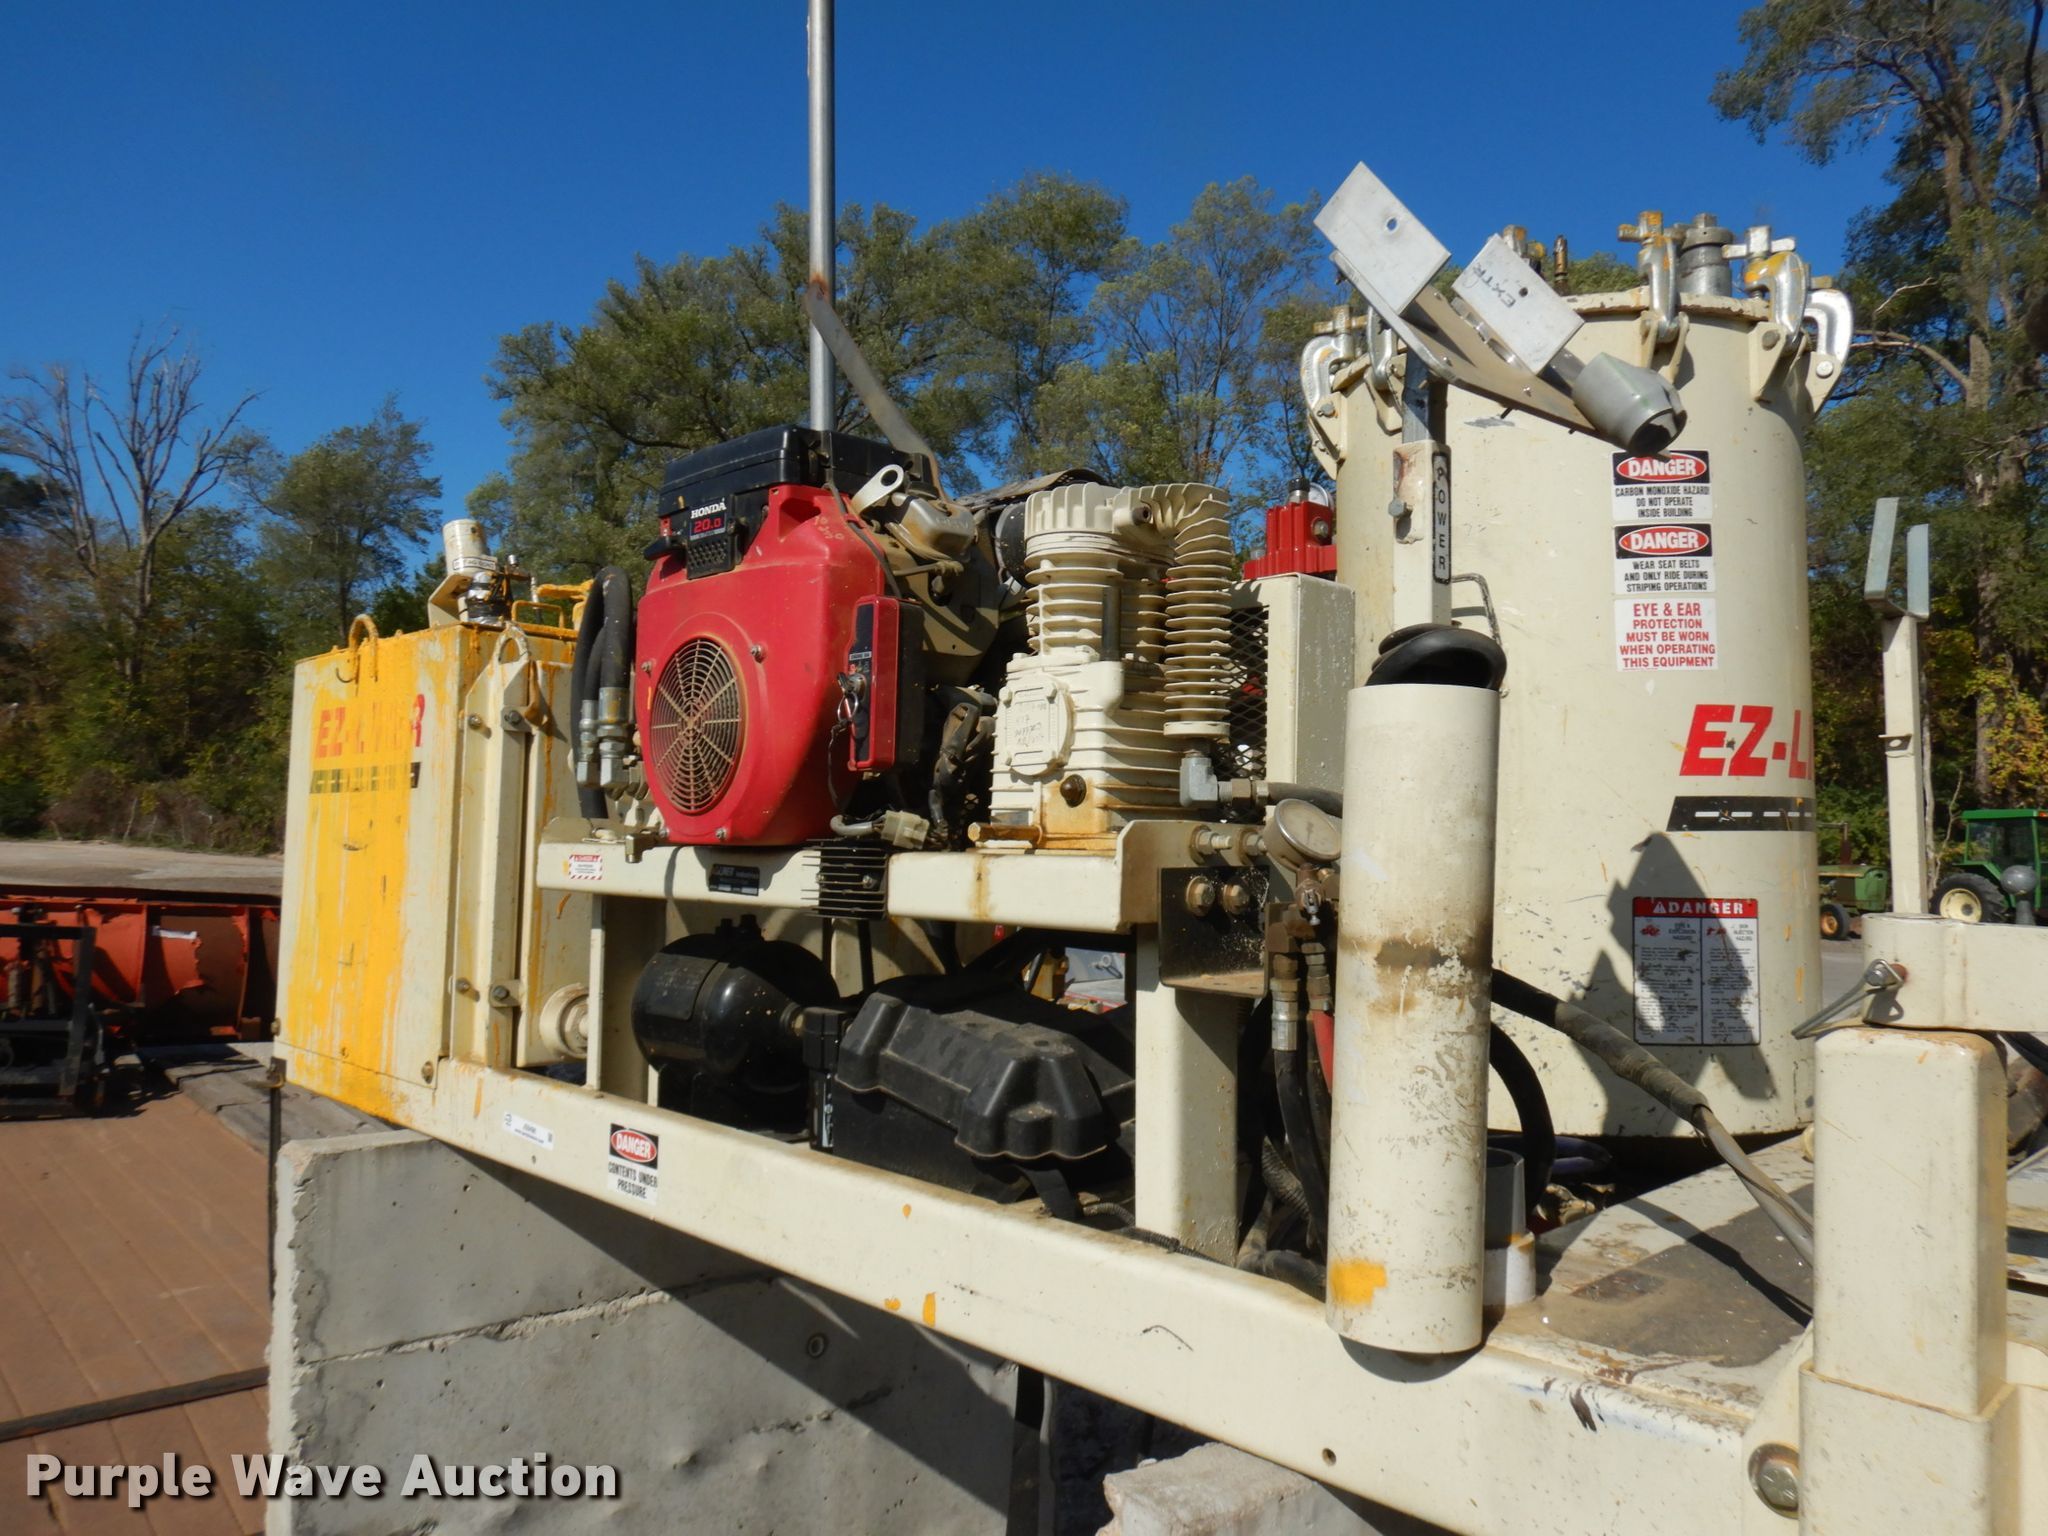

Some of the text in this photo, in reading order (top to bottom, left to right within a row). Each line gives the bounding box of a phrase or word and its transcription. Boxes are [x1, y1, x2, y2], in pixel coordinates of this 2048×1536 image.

[1628, 458, 1697, 477] DANGER
[1615, 486, 1710, 497] CARBON MONOXIDE HAZARD
[1636, 496, 1693, 507] DO NOT OPERATE
[690, 502, 727, 519] HONDA
[1638, 508, 1693, 518] INSIDE BUILDING
[1436, 467, 1447, 570] POWER
[694, 518, 721, 533] 20.0
[1630, 531, 1699, 550] DANGER
[1632, 559, 1700, 570] WEAR SEAT BELTS
[1624, 570, 1709, 582] AND ONLY RIDE DURING
[1626, 581, 1707, 593] STRIPING OPERATIONS
[1633, 602, 1701, 617] EYE & EAR
[1633, 618, 1703, 630] PROTECTION
[1626, 631, 1709, 642] MUST BE WORN
[1620, 643, 1716, 655] WHEN OPERATING
[1622, 656, 1714, 668] THIS EQUIPMENT
[1668, 901, 1743, 914] DANGER
[616, 1133, 651, 1159] DANGER
[608, 1161, 658, 1188] CONTENTS UNDER
